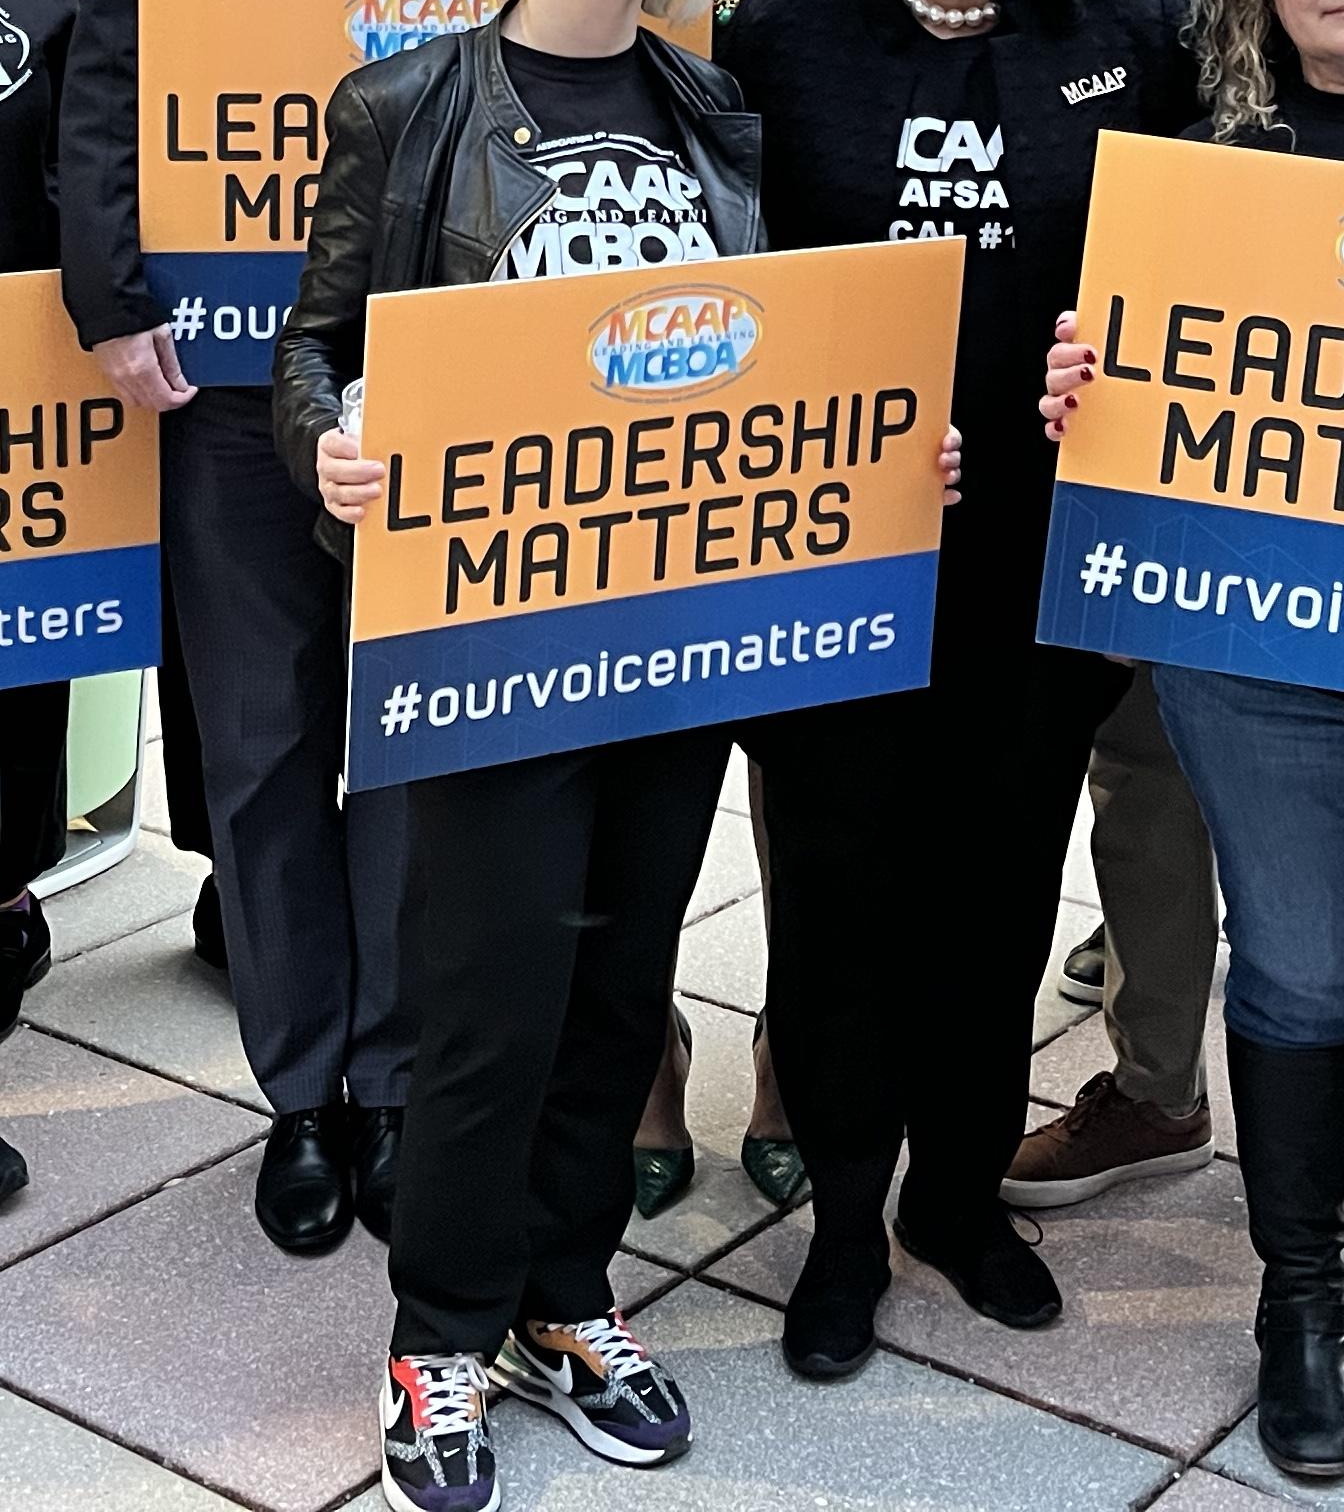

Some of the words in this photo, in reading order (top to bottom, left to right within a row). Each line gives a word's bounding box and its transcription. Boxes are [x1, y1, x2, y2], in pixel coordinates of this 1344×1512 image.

[1060, 66, 1127, 105] MCAAP
[533, 159, 703, 212] CAAP
[898, 178, 1010, 209] AFSA
[578, 209, 624, 224] AND
[635, 209, 707, 224] LEARNI
[594, 343, 652, 357] LEADING
[659, 338, 684, 348] AND
[691, 330, 756, 346] LEARNING
[608, 297, 747, 346] MCAAP
[606, 341, 740, 388] MCBOA
[386, 388, 918, 532] LEADERSHIP
[446, 481, 851, 615] MATTERS
[380, 611, 896, 738] #ourvoicematters
